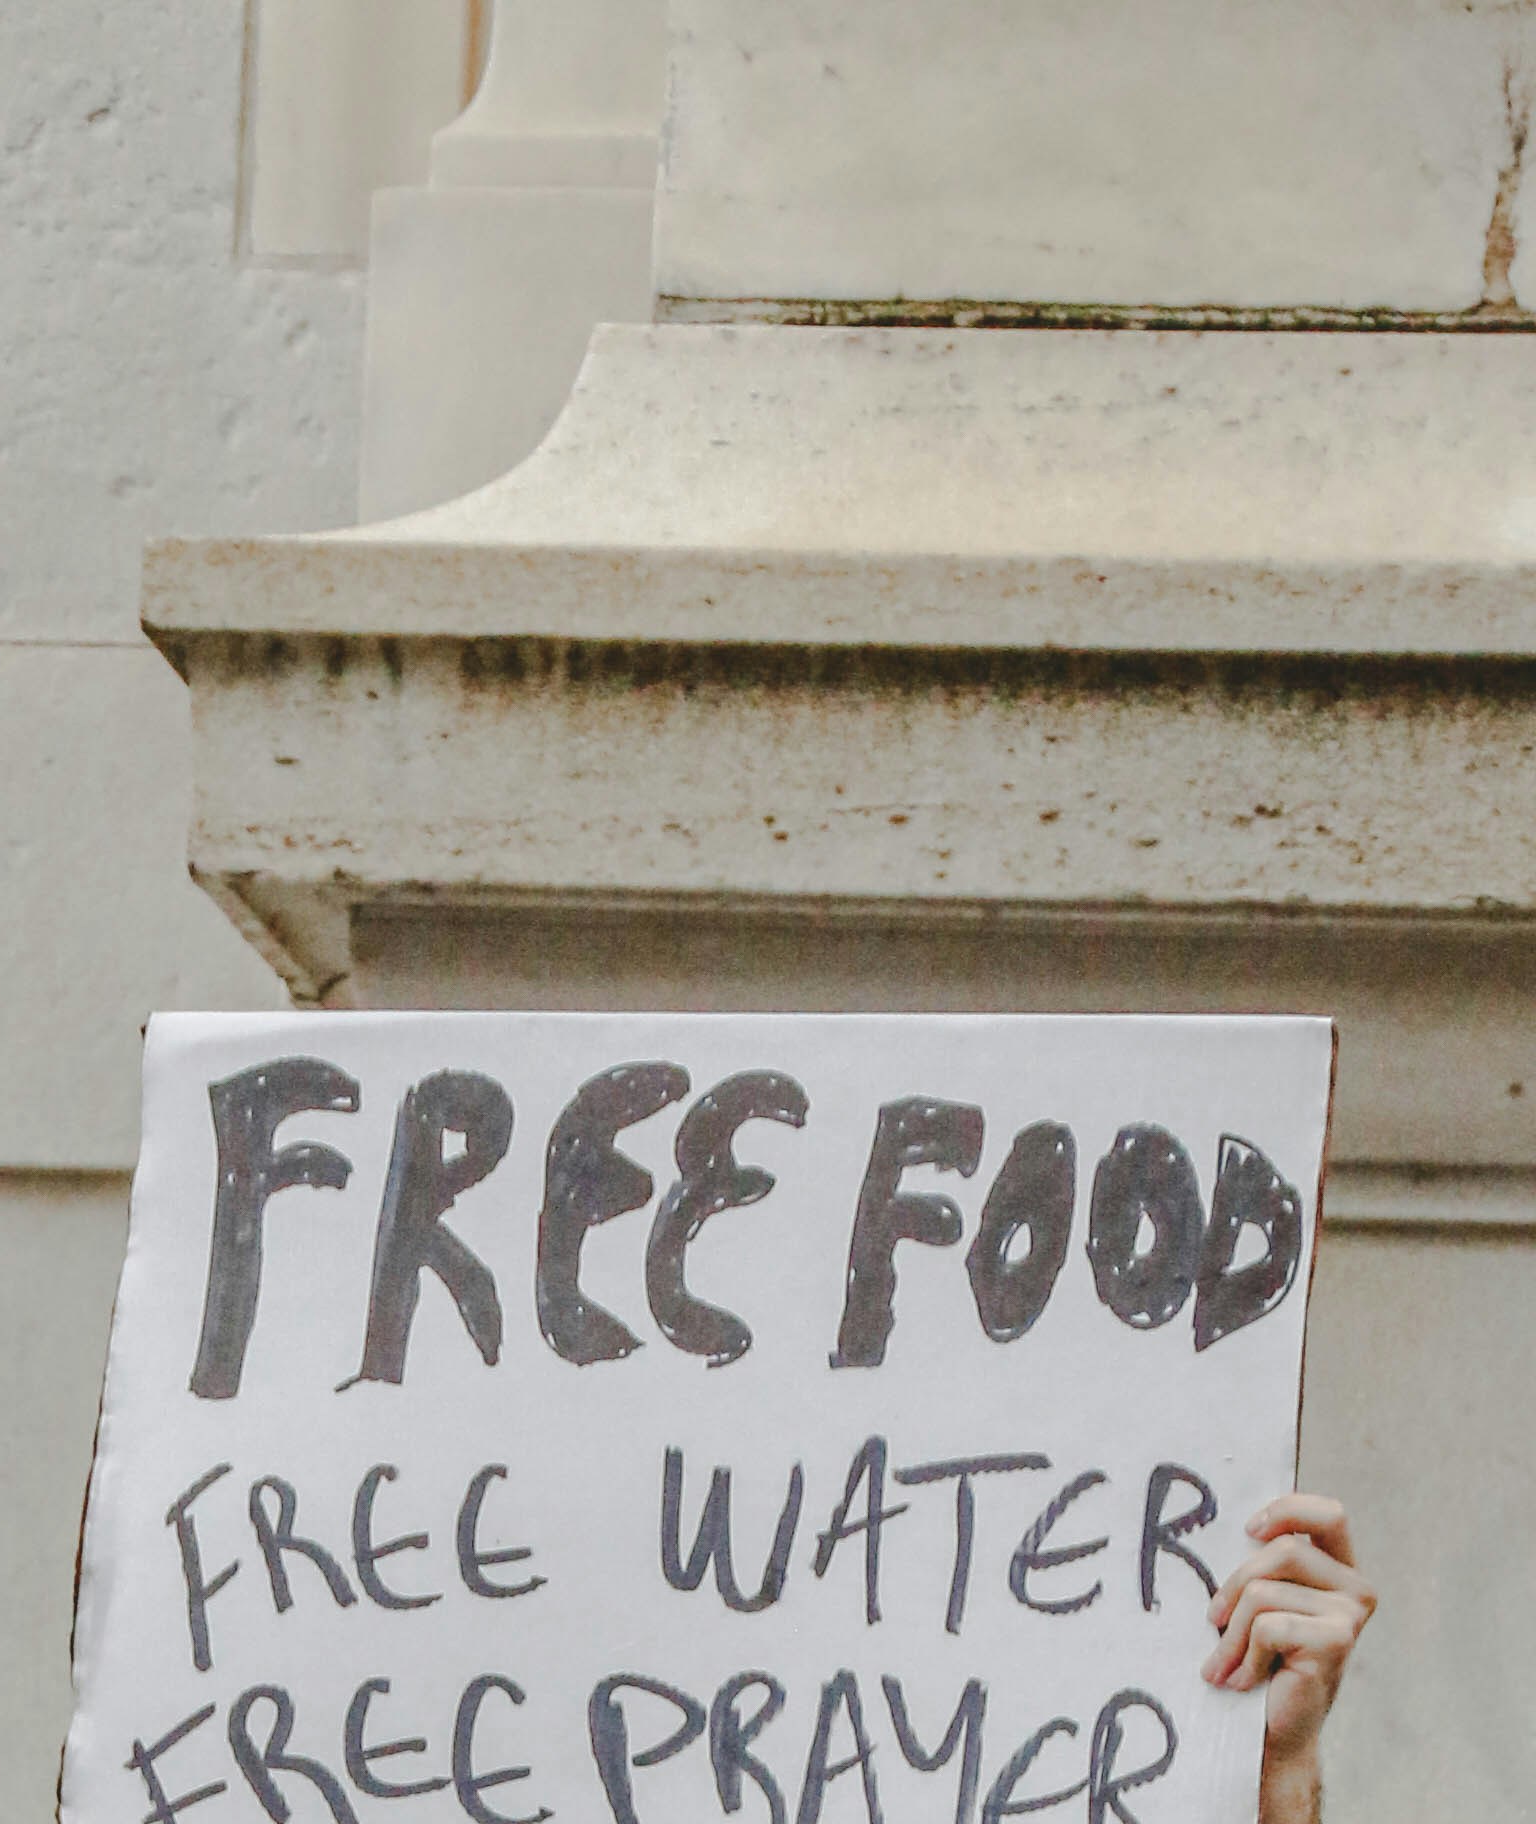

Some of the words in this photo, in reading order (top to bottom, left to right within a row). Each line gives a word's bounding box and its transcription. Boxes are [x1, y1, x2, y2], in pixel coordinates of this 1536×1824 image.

[188, 1056, 808, 1400] FREE
[828, 1095, 1304, 1370] FOOD
[165, 1462, 548, 1672] FREE
[662, 1436, 1220, 1636] WATER
